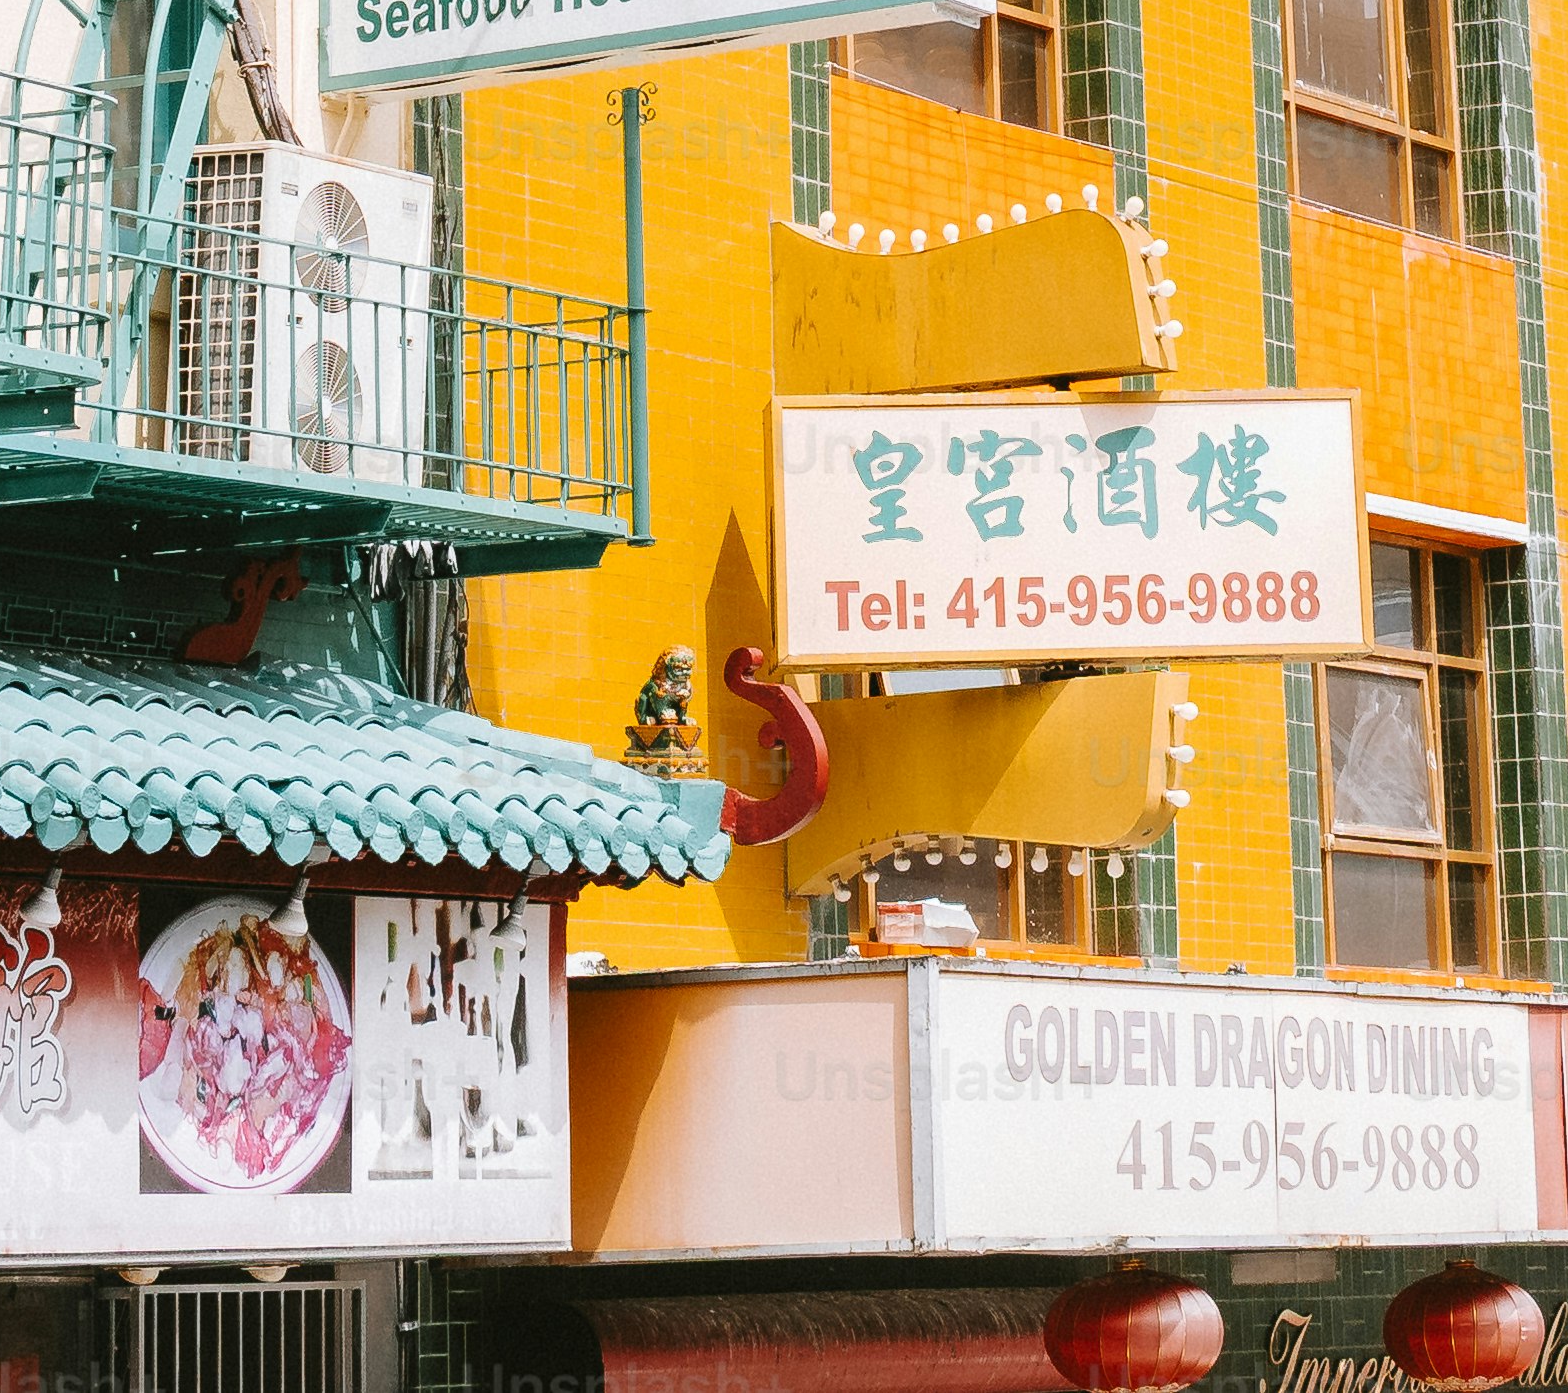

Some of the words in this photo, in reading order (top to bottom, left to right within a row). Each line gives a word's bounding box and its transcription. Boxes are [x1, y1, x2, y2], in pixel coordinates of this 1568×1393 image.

[851, 423, 1288, 546] 皇宮酒樓
[824, 579, 926, 633] Tel:
[946, 569, 1322, 630] 415-956-9888
[1004, 1003, 1178, 1089] GOLDEN
[1192, 1011, 1357, 1093] DRAGON
[1365, 1020, 1496, 1099] DINING
[1116, 1118, 1482, 1192] 415-956-9888
